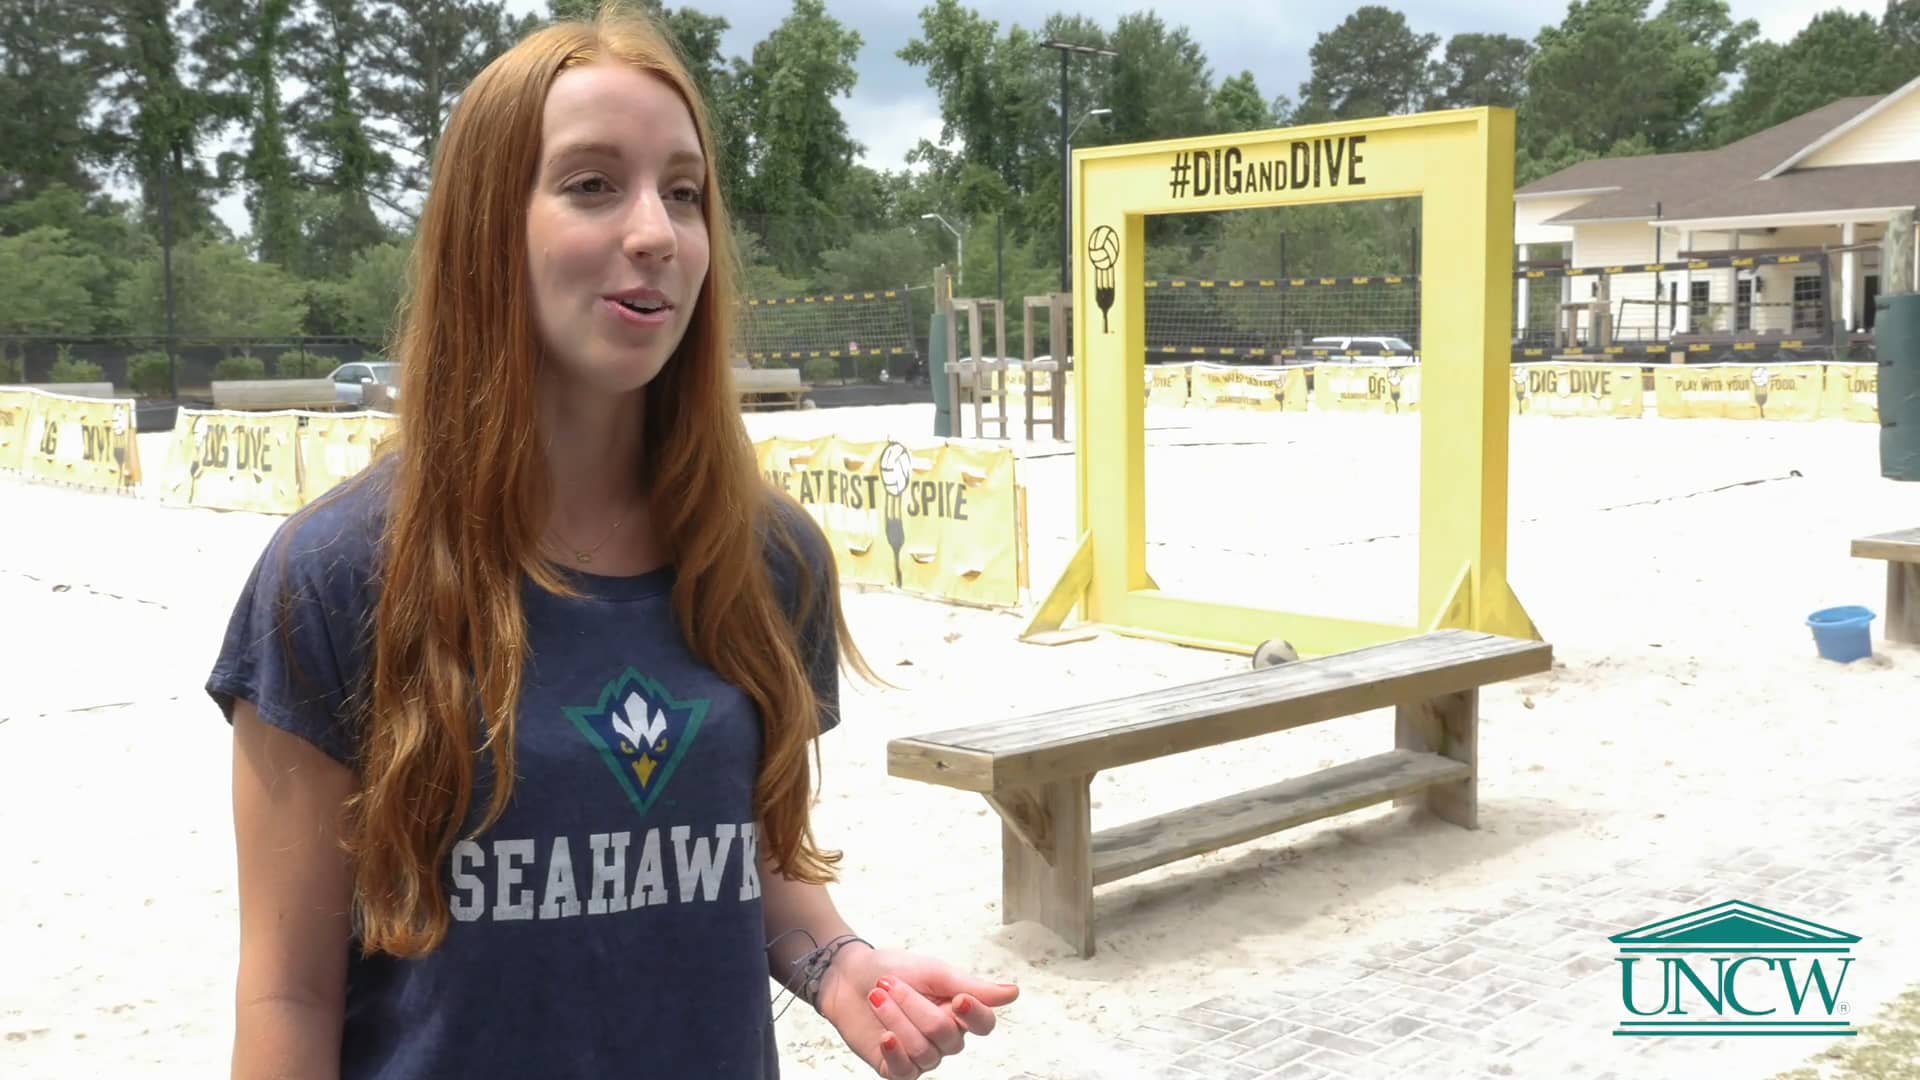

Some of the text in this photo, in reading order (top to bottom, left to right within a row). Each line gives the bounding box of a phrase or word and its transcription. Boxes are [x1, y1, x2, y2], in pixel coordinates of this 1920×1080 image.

[1529, 369, 1611, 395] DIG DIVE
[800, 470, 824, 504] AT
